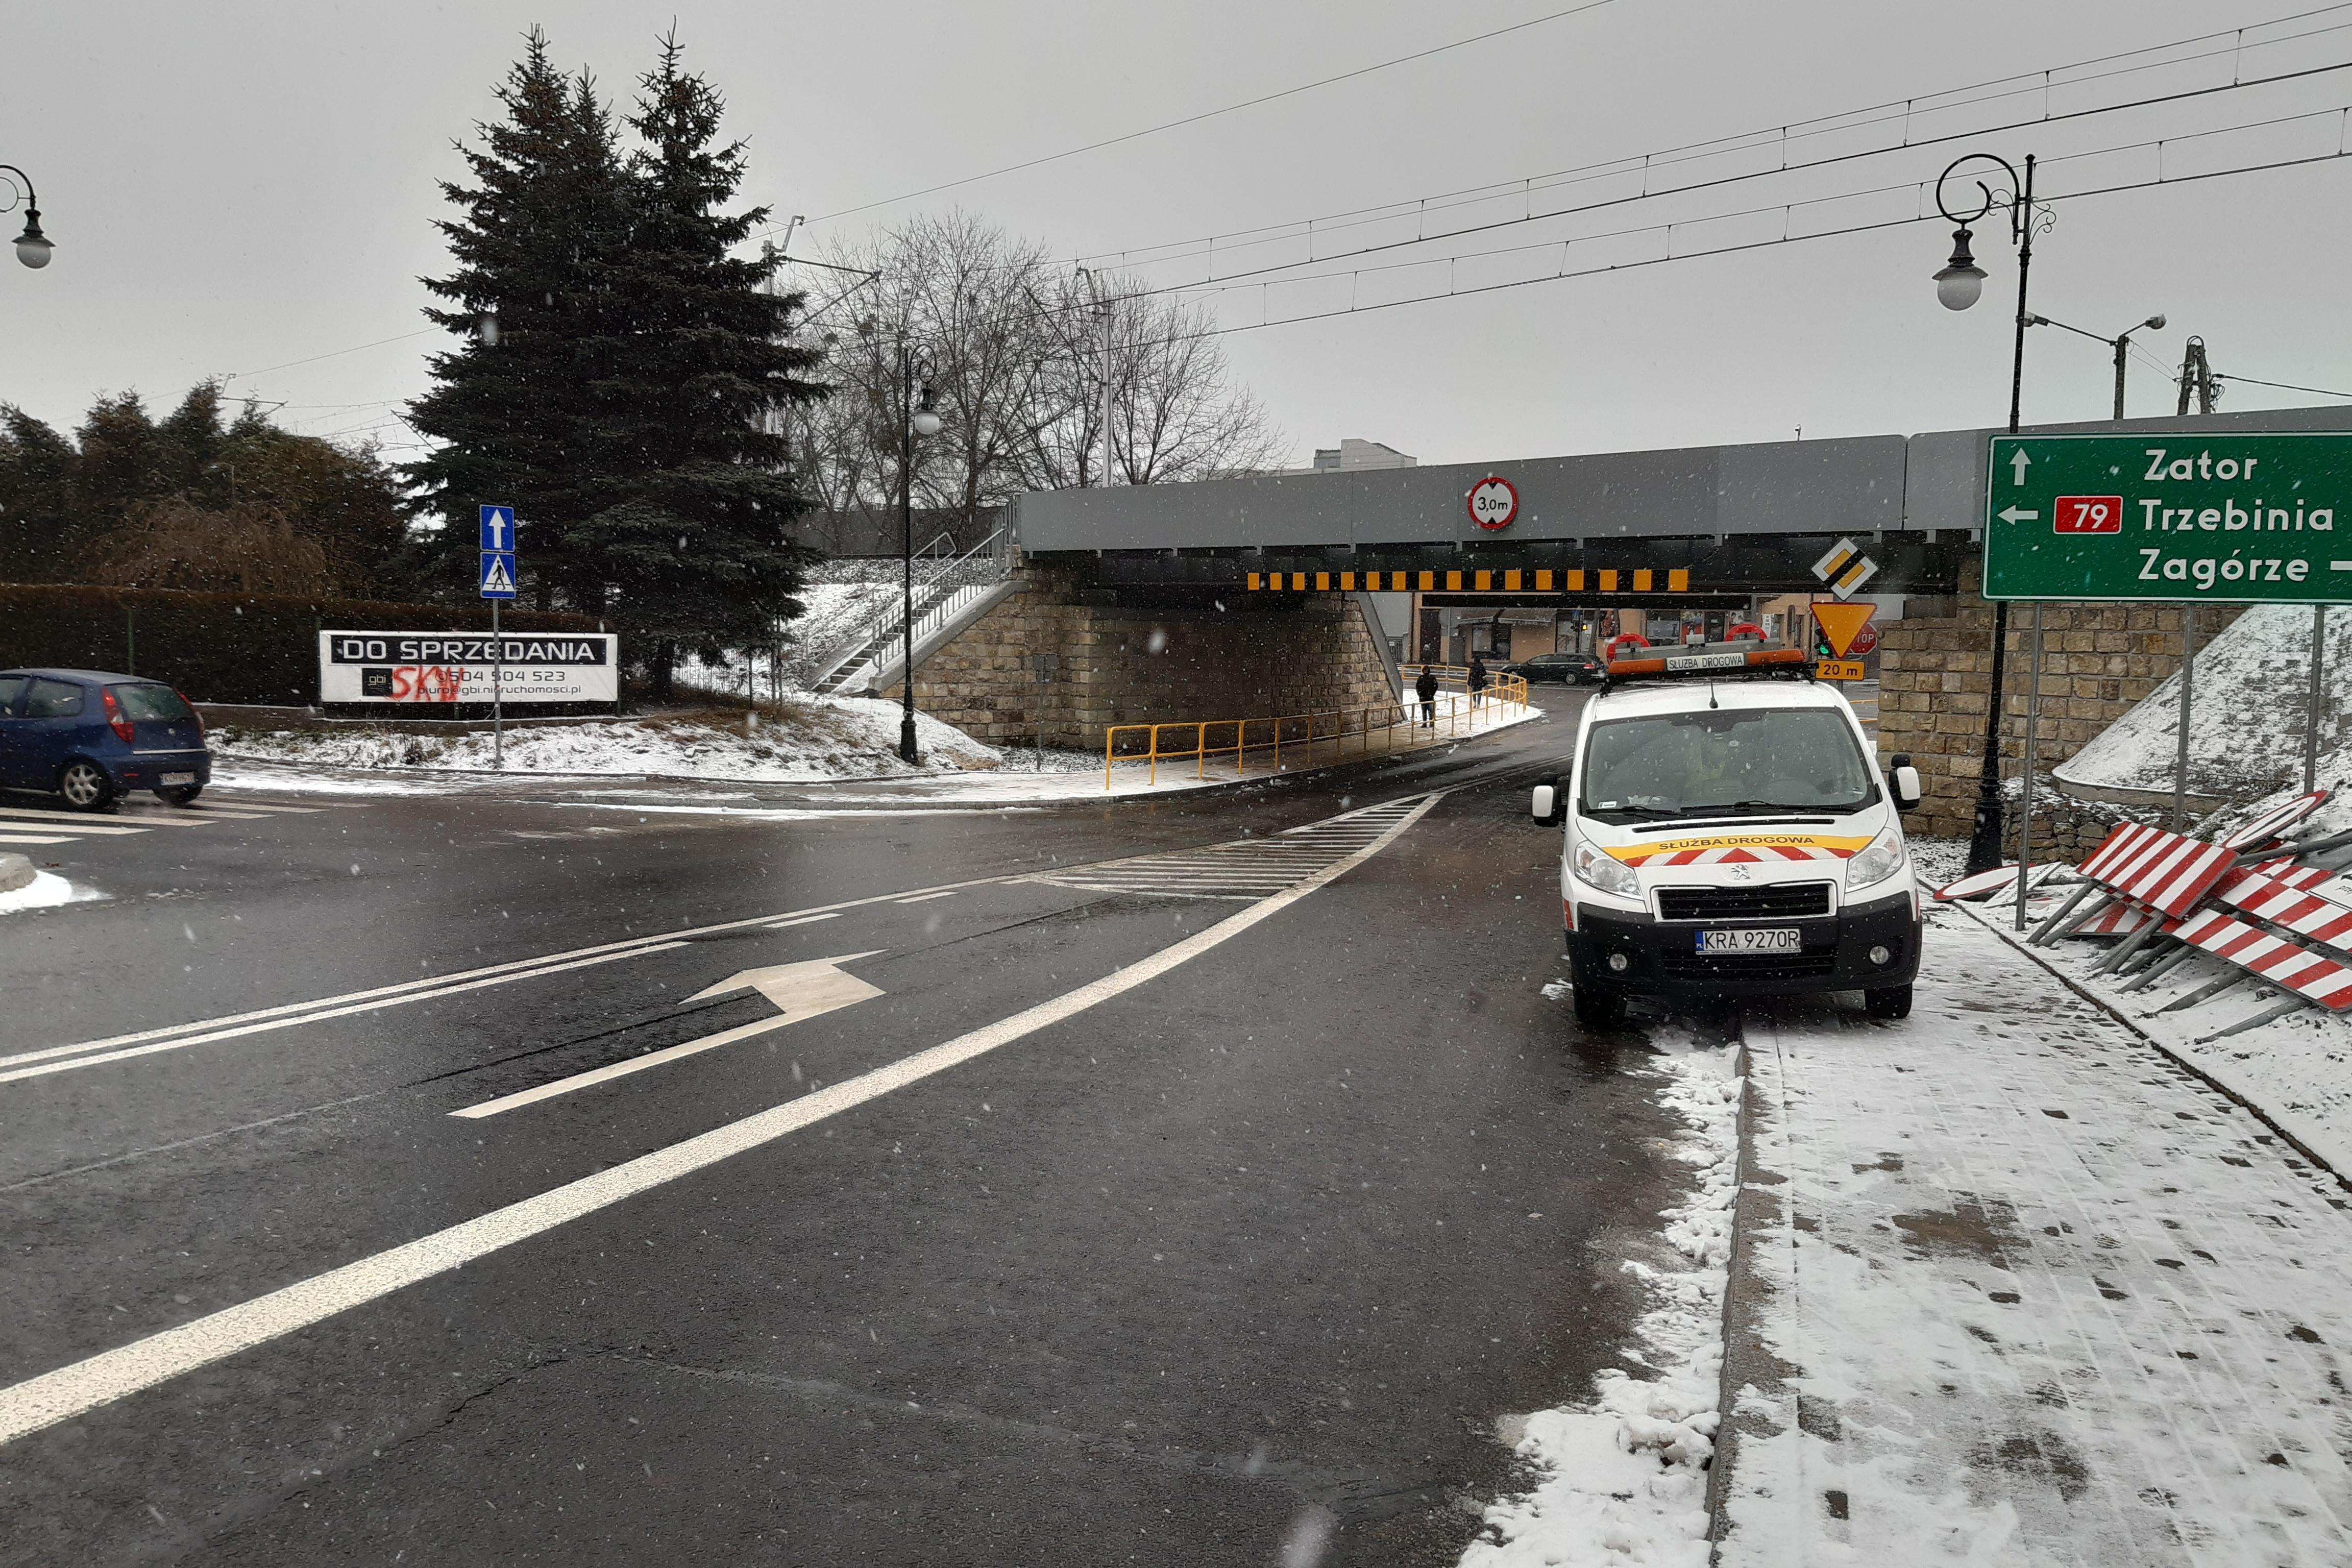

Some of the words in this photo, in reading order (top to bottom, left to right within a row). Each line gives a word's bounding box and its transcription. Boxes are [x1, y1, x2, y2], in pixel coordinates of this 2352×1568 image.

[2144, 449, 2258, 481] Zator
[1477, 497, 1508, 512] 3,0m
[2073, 503, 2109, 529] 79
[2139, 499, 2334, 531] Trzebinia
[2138, 549, 2310, 591] Zagórze
[1856, 633, 1874, 643] TOP
[343, 640, 387, 660] DO
[400, 640, 596, 661] SPRZEDANIA
[1702, 656, 1743, 667] DROGOWA
[449, 671, 484, 681] 504
[532, 671, 566, 681] 523
[1823, 664, 1840, 675] 20
[1846, 668, 1858, 676] m
[368, 674, 386, 685] gbi
[418, 685, 581, 696] biuro@gbi.niruchomosci.pl
[1659, 839, 1724, 850] SŁUŻBA
[1728, 836, 1815, 844] DROGOWA
[1704, 932, 1739, 950] KRA
[1744, 930, 1799, 948] 9270R
